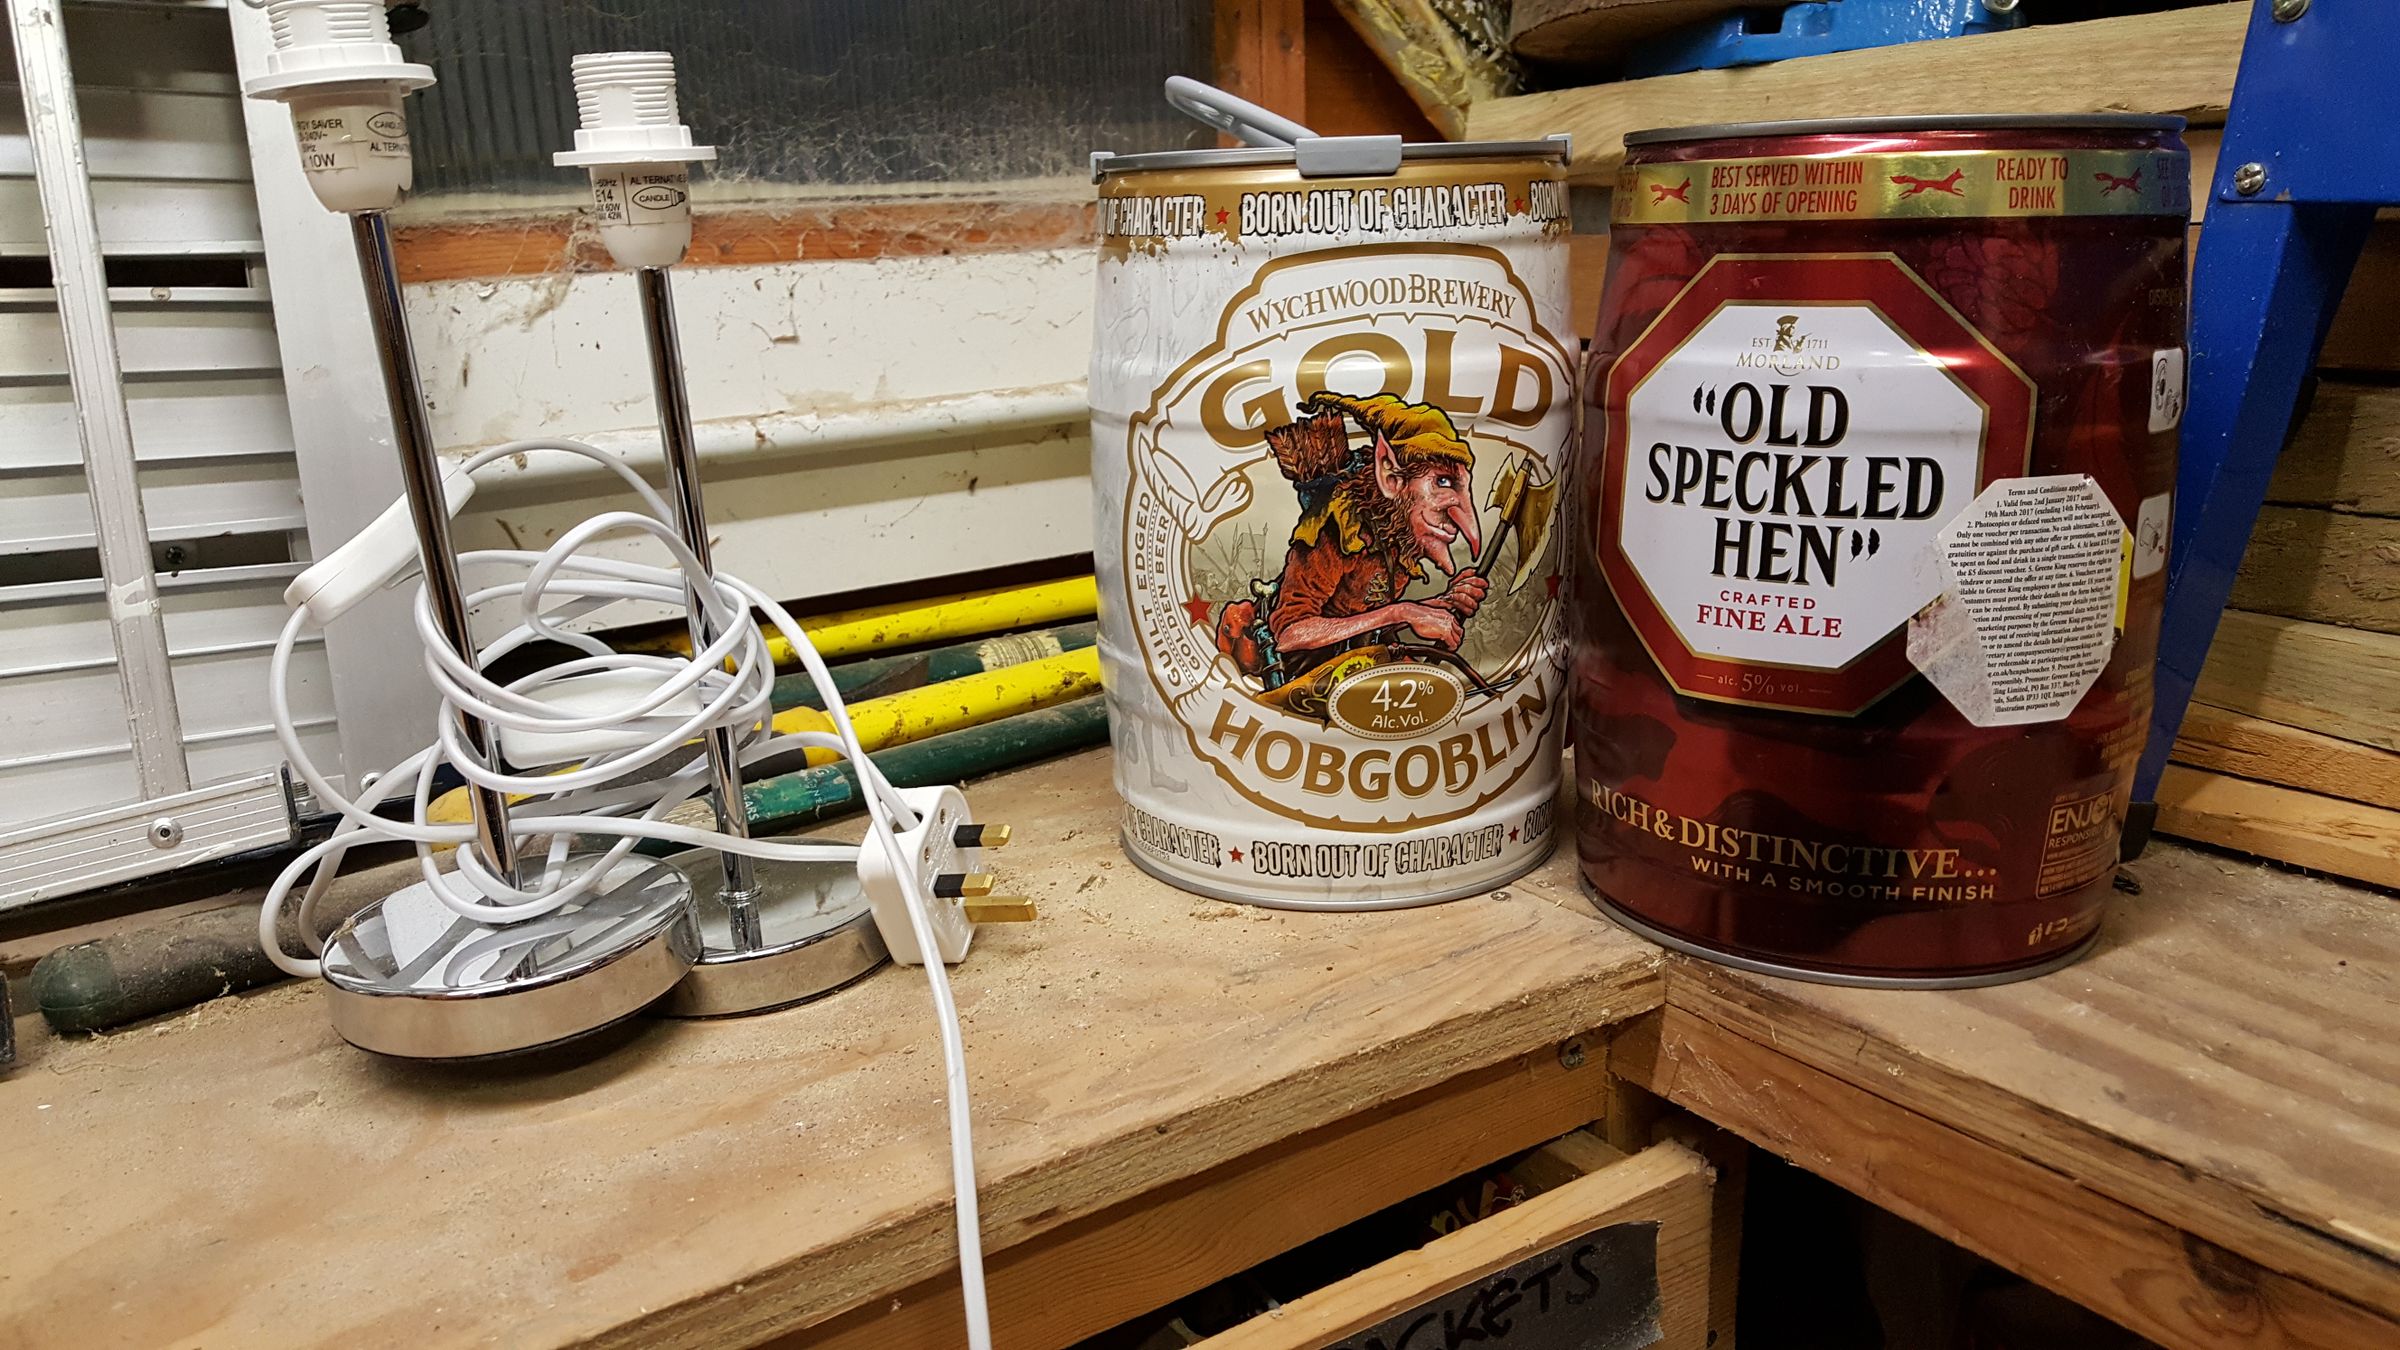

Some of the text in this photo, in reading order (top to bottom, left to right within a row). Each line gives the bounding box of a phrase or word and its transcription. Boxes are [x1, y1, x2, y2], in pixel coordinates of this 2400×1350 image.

[311, 119, 343, 130] SAVER
[1711, 161, 1864, 190] BEST SERVED WITHIN
[1996, 157, 2068, 182] READY TO
[639, 194, 670, 202] CANDLE
[1239, 183, 1507, 236] BORN OUT OF CHARACTER
[1710, 189, 1857, 215] 3 DAYS OF OPENING
[2009, 186, 2056, 210] DRINK
[1106, 198, 1119, 235] OF
[1120, 195, 1207, 237] CHARACTER
[1807, 339, 1828, 349] 1711
[1737, 352, 1841, 376] MORLAND
[1200, 328, 1553, 449] GOLD
[1645, 442, 1945, 520] SPECKLED
[1956, 531, 1971, 539] Only
[1974, 520, 2010, 529] Photocopies
[1947, 550, 1976, 558] gratuities
[1986, 549, 2007, 557] against
[1959, 559, 1976, 568] spent
[2012, 556, 2028, 564] drink
[1135, 491, 1183, 687] GUILT EDGED
[1154, 514, 1202, 671] GOLDEN BEER
[1720, 590, 1816, 610] CRAFTED
[2007, 585, 2021, 594] King
[2007, 594, 2028, 603] provide
[1696, 603, 1843, 639] FINE ALE
[2003, 612, 2032, 622] processing
[1371, 679, 1434, 712] 4.2%
[1717, 674, 1738, 686] alc.
[1741, 673, 1774, 696] 5%
[1207, 676, 1549, 800] HOBGOBLIN
[1137, 809, 1222, 868] CHARACTER
[1251, 823, 1505, 878] BORN OUT OF CHARACTER
[1692, 856, 1995, 903] WITH A SMOOTH FINISH
